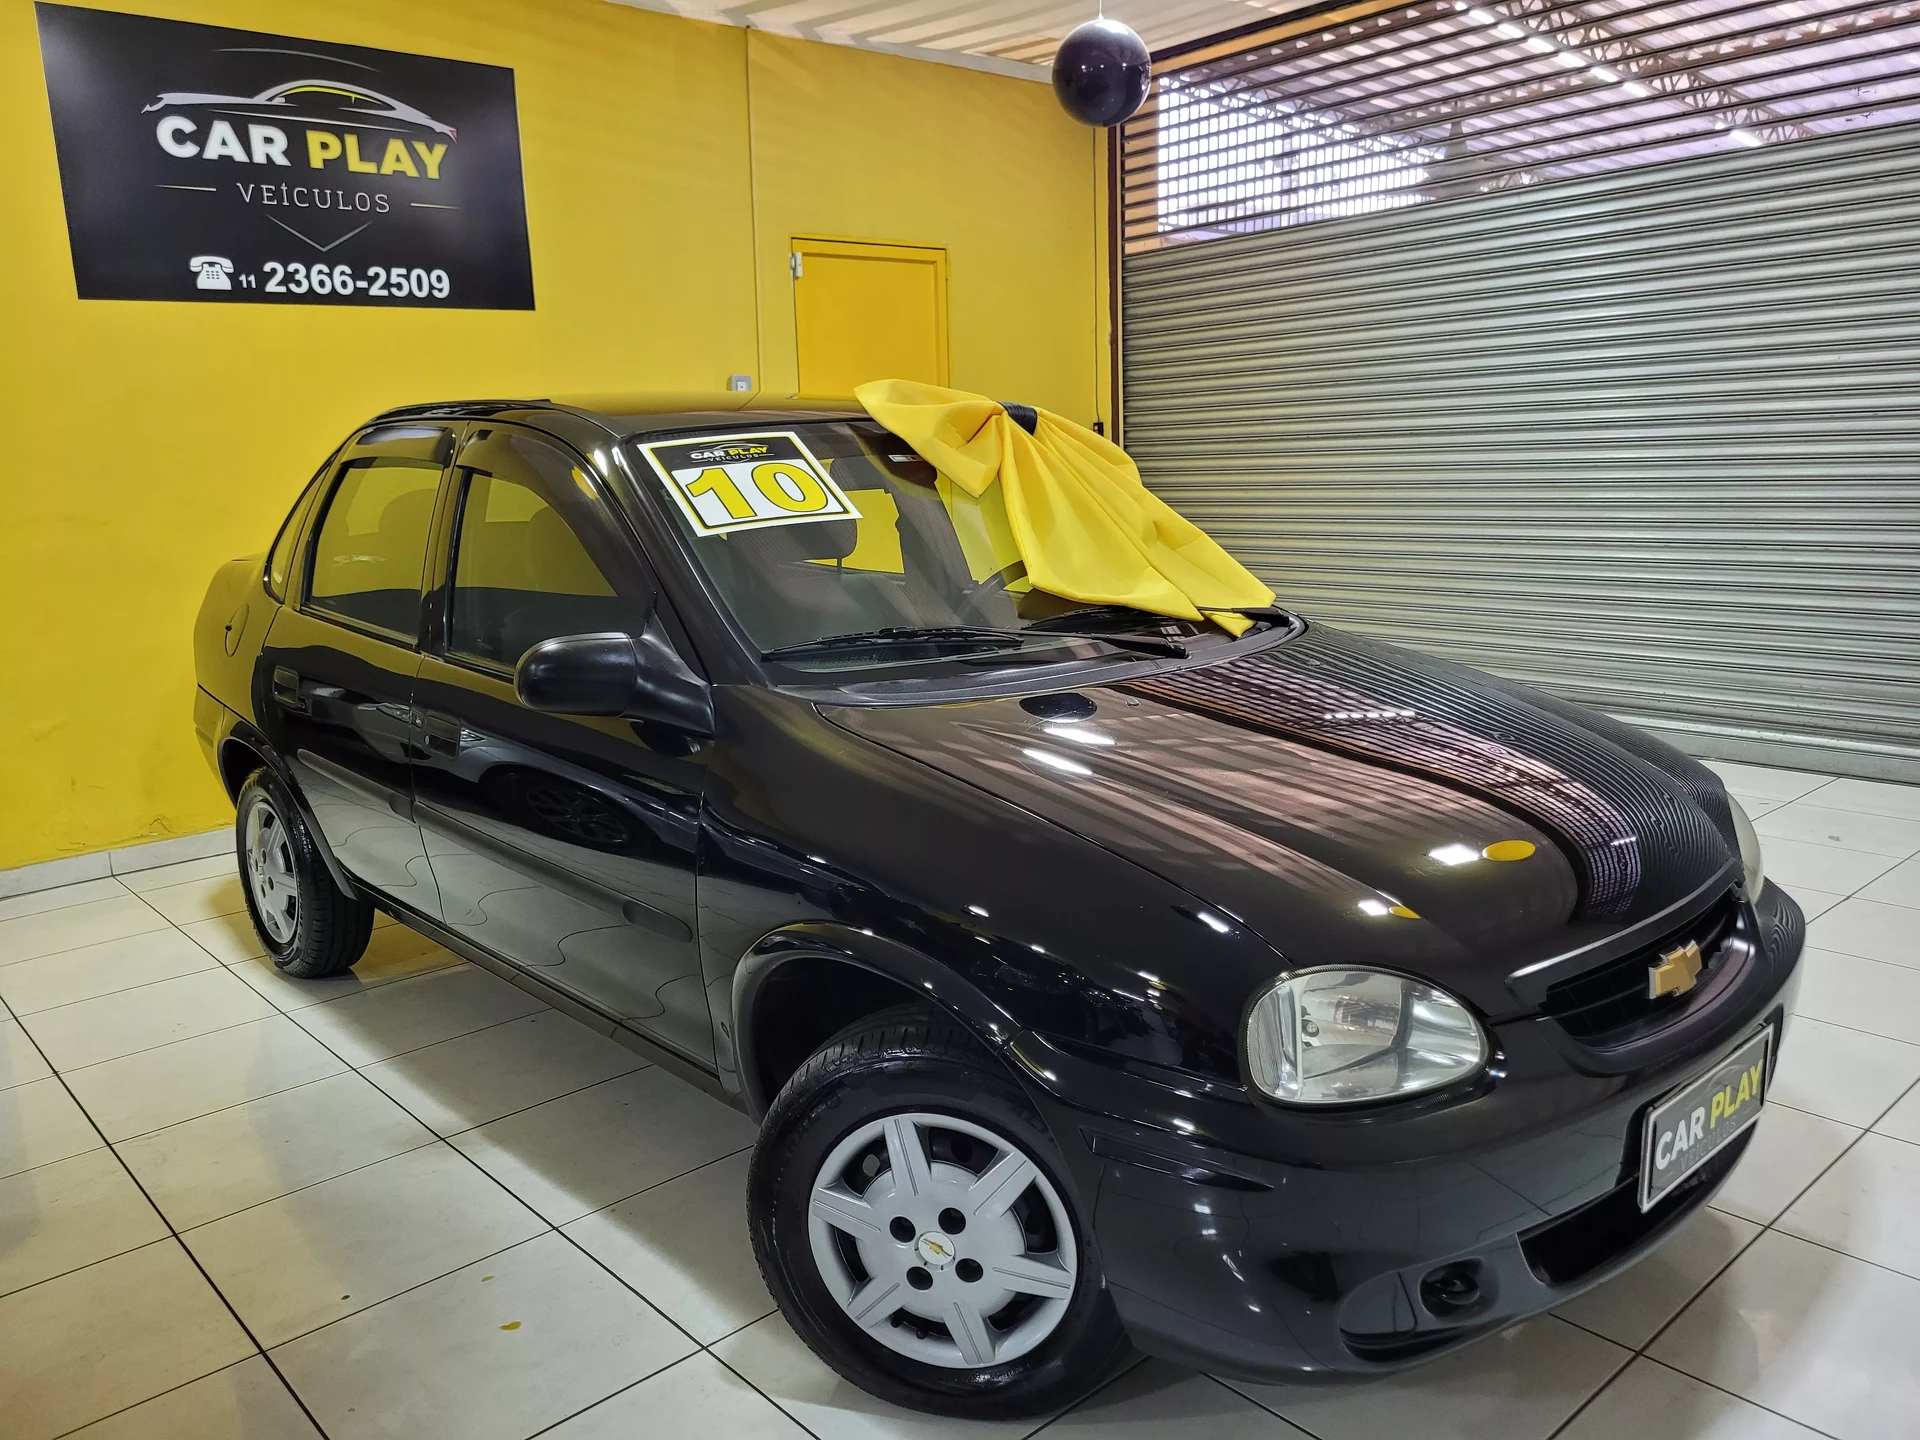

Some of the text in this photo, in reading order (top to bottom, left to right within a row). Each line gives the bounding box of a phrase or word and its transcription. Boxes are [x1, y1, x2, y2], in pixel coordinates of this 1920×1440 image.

[156, 115, 449, 180] CAR PLAY
[238, 261, 451, 299] 11 2366-2509
[690, 446, 768, 460] CAR PLAY
[685, 462, 829, 519] 10
[1655, 1059, 1764, 1171] CAR PLAY
